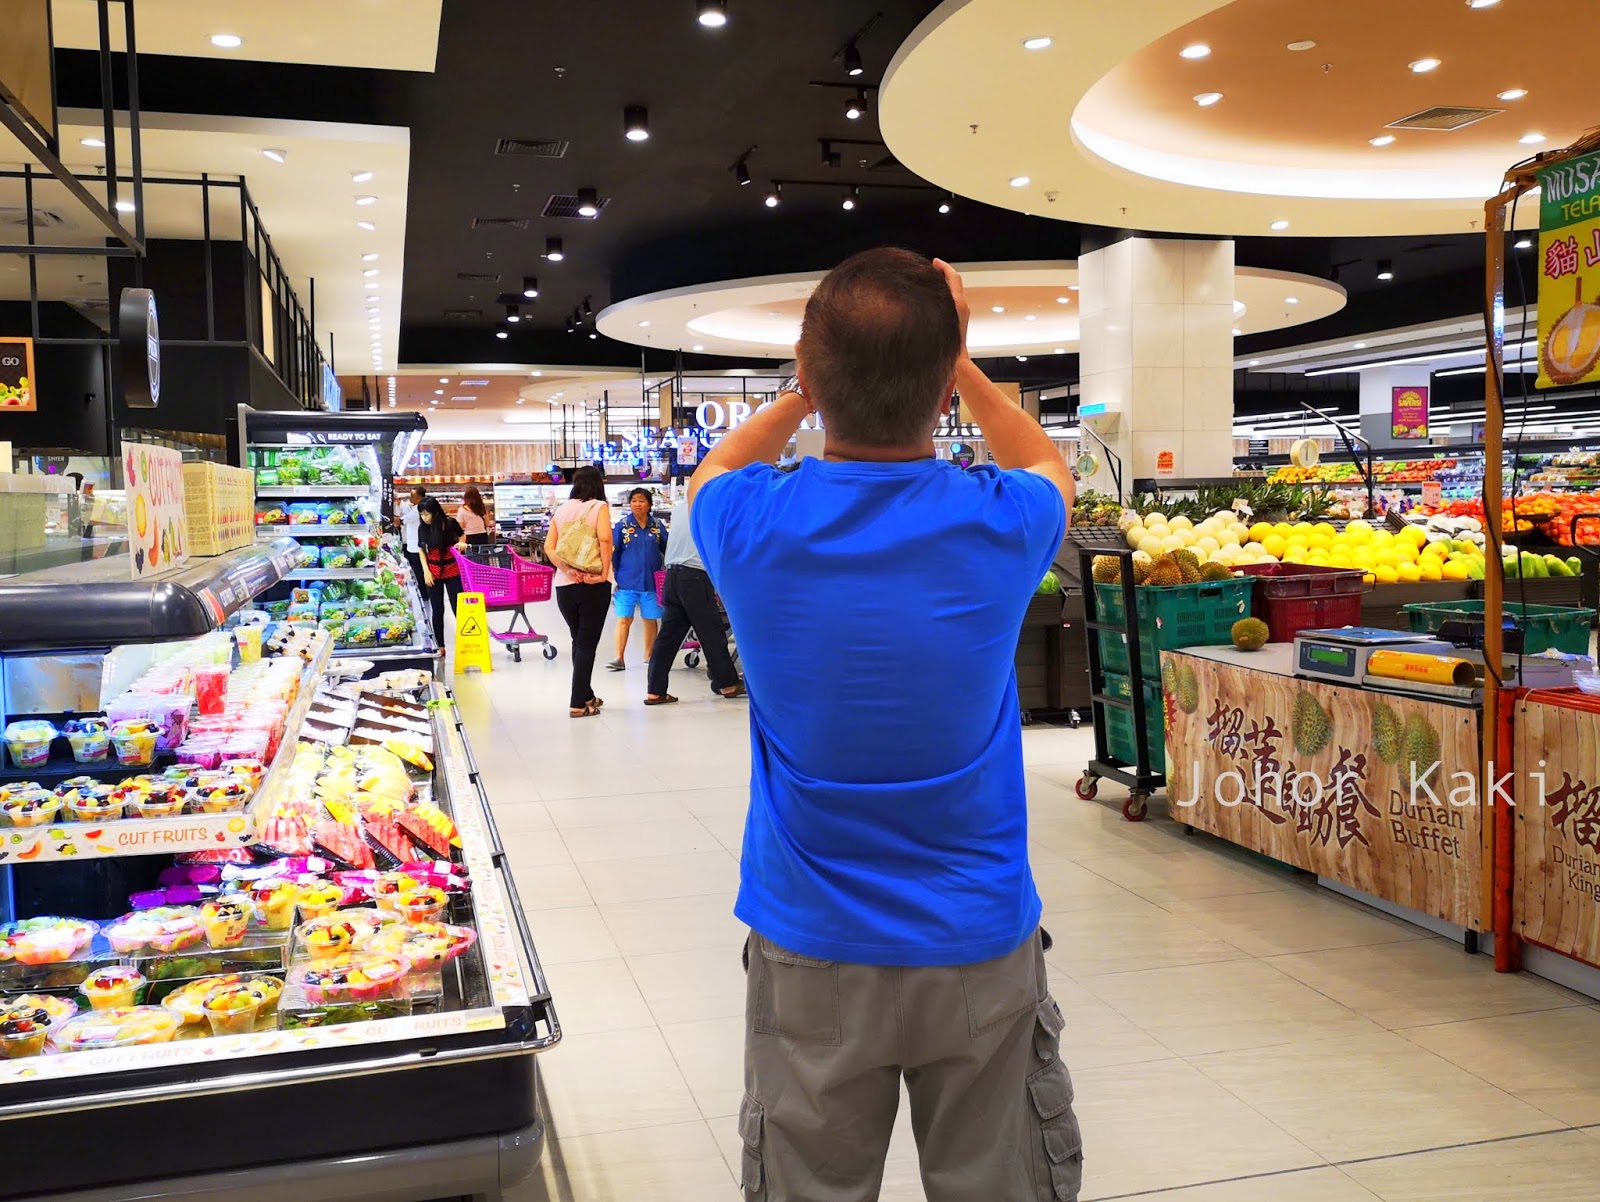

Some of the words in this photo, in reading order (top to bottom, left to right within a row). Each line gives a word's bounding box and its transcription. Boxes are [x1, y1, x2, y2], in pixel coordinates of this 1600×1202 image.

[2, 357, 19, 366] GO
[1389, 789, 1465, 830] Durian
[118, 832, 149, 846] CUT
[153, 827, 208, 844] FRUITS
[1389, 819, 1460, 859] Buffet
[1552, 845, 1600, 876] Durian
[413, 1016, 462, 1031] RUITS
